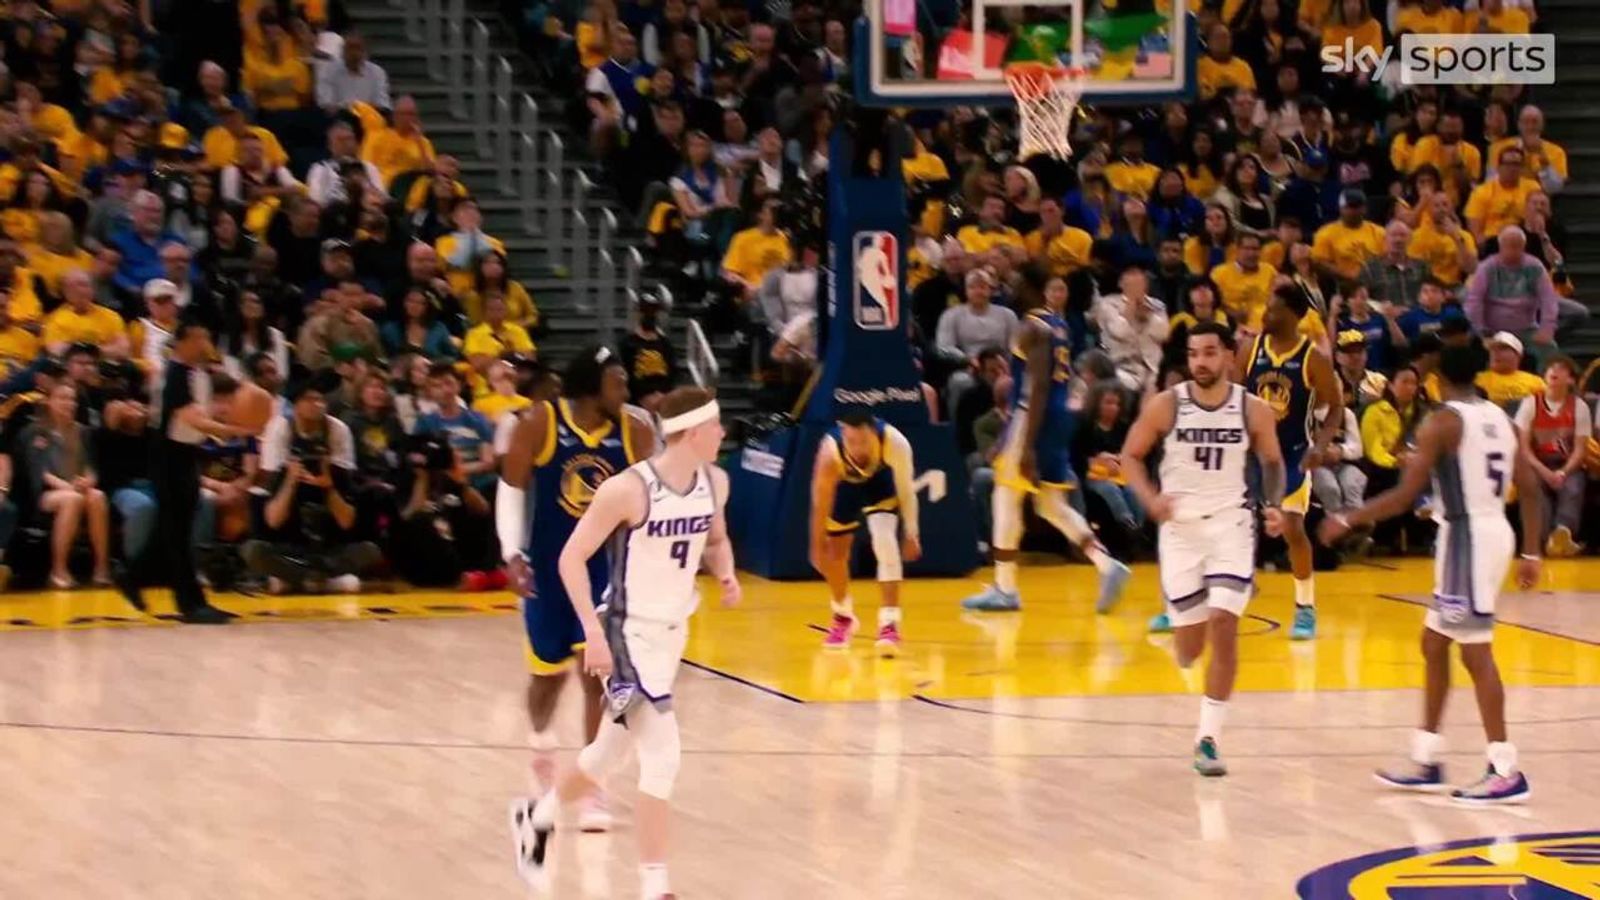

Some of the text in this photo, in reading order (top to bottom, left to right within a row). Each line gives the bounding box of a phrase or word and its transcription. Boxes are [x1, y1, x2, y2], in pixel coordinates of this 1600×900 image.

[1176, 428, 1243, 443] KINGS
[1194, 447, 1224, 470] 41
[1485, 452, 1503, 497] 5
[669, 540, 691, 569] 9
